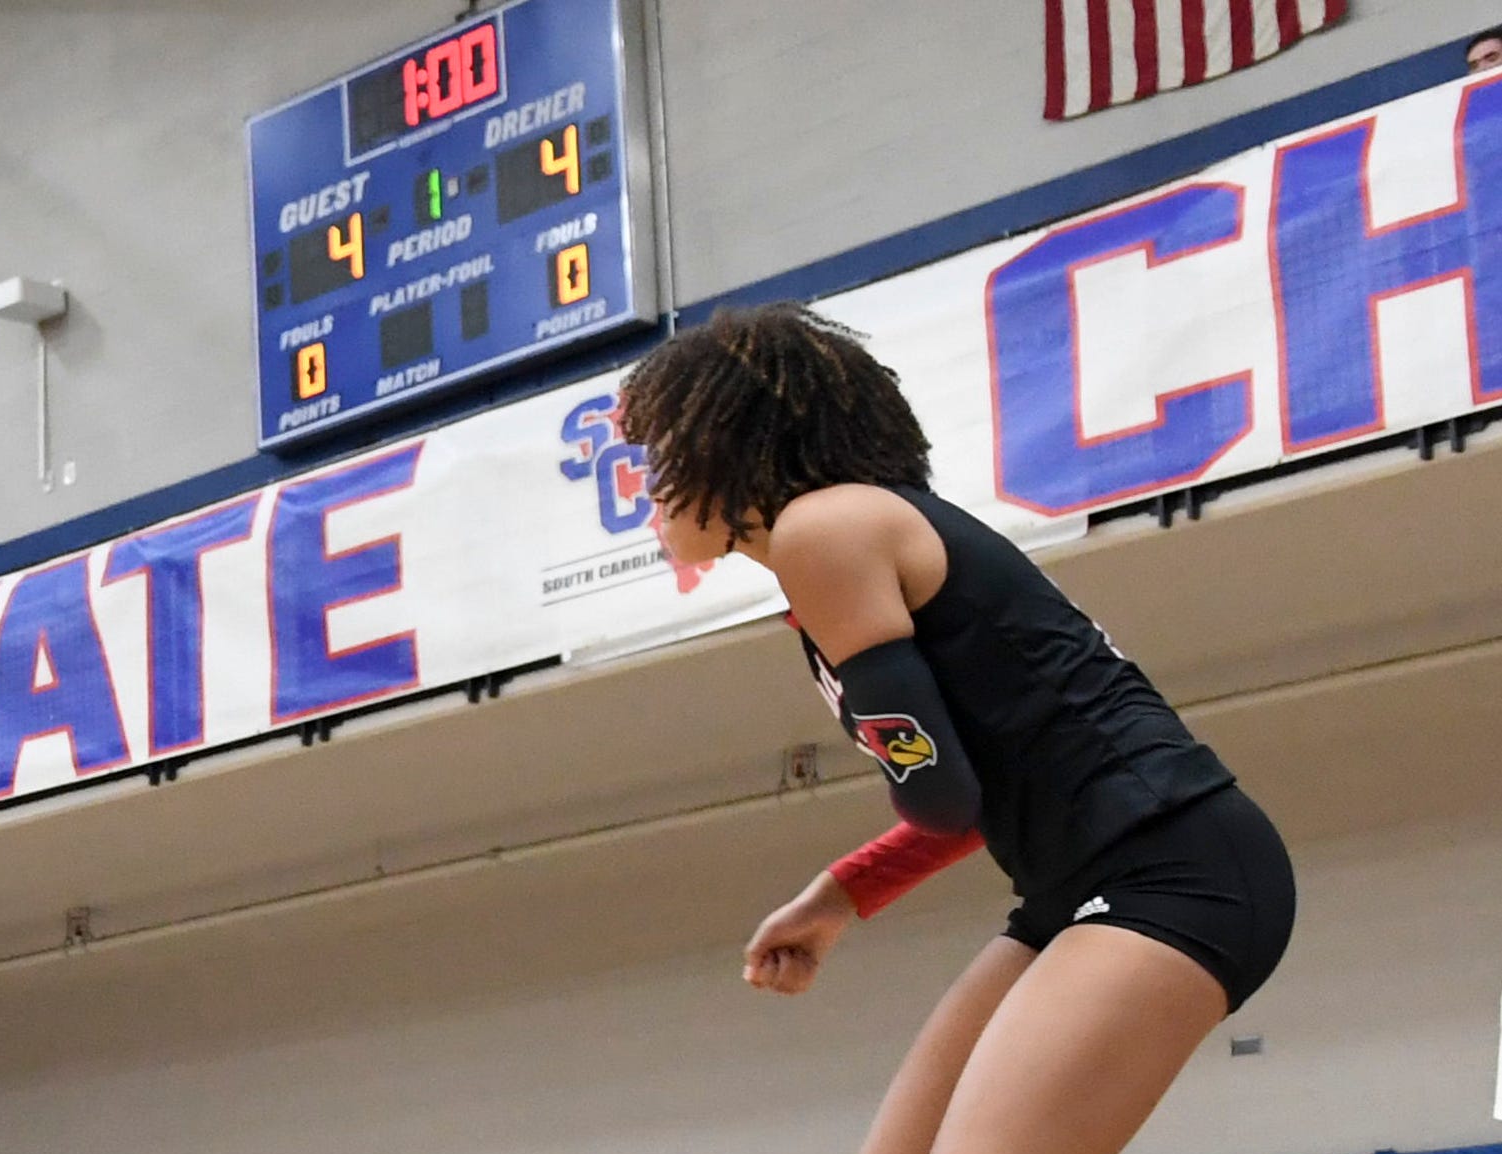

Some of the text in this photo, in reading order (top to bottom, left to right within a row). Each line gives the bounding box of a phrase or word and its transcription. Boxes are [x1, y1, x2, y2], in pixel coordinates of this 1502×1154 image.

[403, 23, 497, 127] 1:00
[485, 82, 585, 148] DREHER
[540, 124, 579, 194] 4
[279, 172, 370, 233] GUEST
[428, 168, 441, 219] 1
[328, 212, 364, 279] 4
[387, 215, 472, 268] PERIOD
[536, 213, 597, 253] FOULS
[370, 254, 494, 316] PLAYER-FOUL
[556, 243, 589, 305] 0
[280, 314, 333, 350] FOULS
[536, 299, 606, 341] POINTS
[297, 341, 326, 399] 0
[376, 359, 440, 396] MATCH
[279, 395, 340, 431] POINTS
[542, 567, 594, 595] SOUTH
